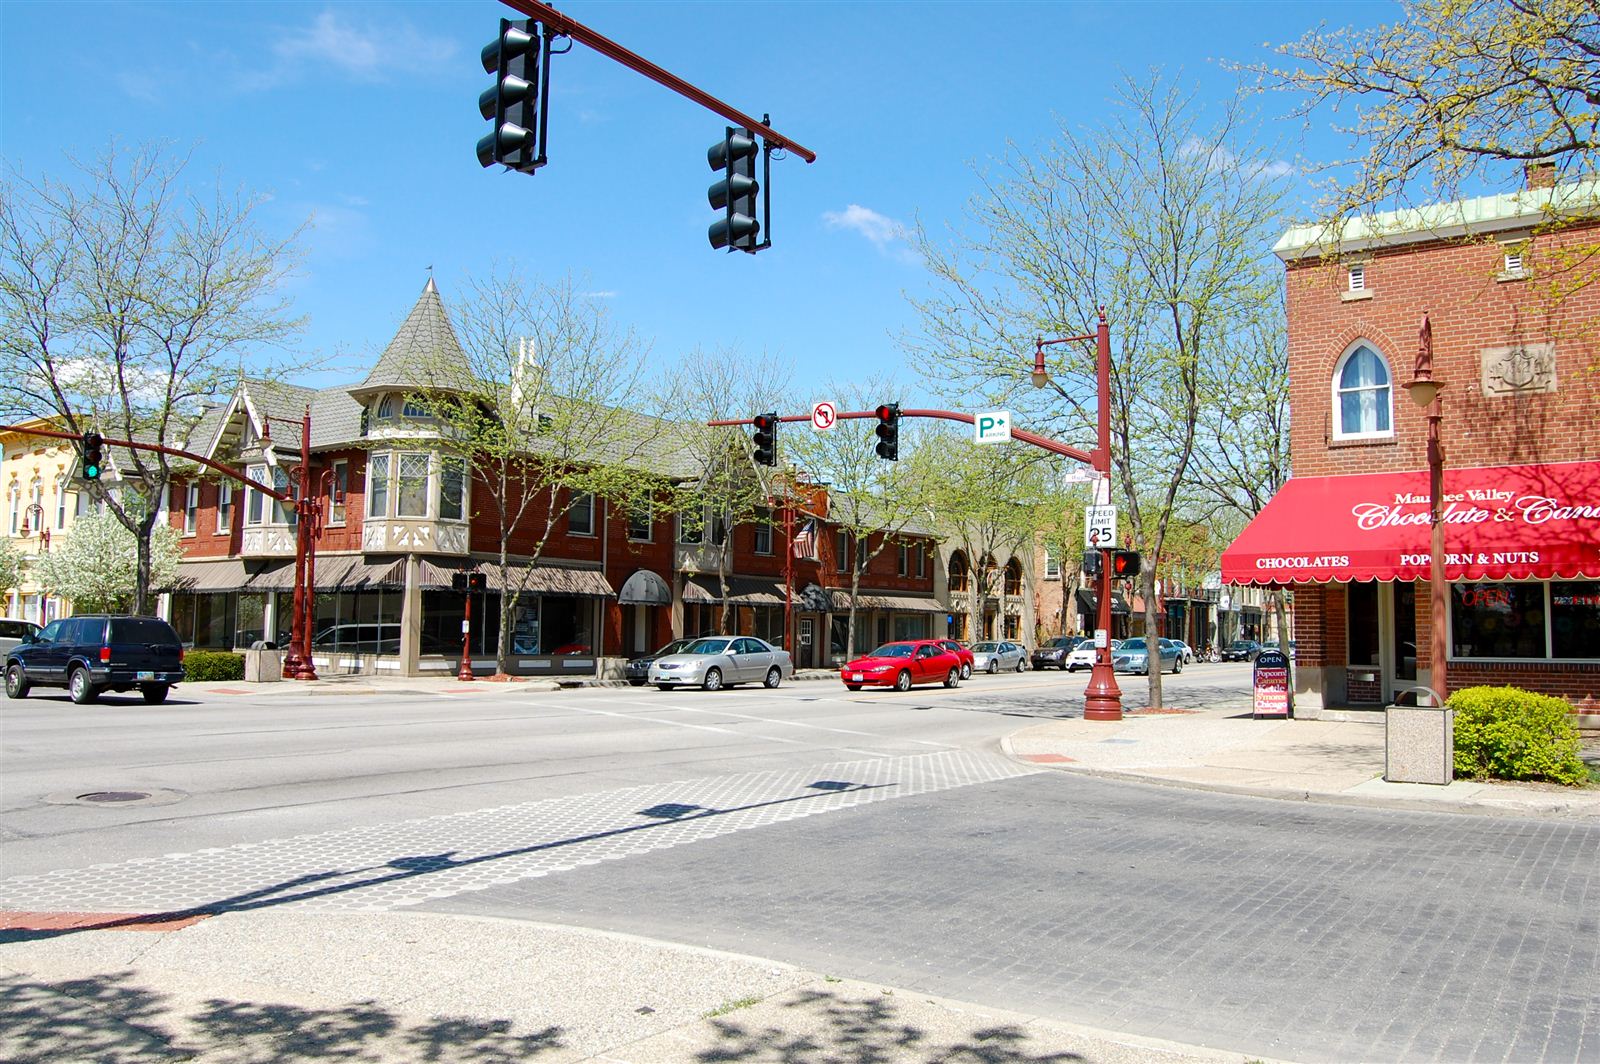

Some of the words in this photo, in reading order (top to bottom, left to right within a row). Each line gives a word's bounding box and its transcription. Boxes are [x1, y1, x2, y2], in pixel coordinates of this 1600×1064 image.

[1466, 489, 1515, 502] Valley
[1352, 503, 1489, 530] Choclate
[1494, 508, 1515, 522] &
[1089, 528, 1112, 542] 25
[1256, 556, 1350, 569] CHOCOLATES
[1400, 553, 1474, 566] POPORN
[1477, 553, 1490, 564] &
[1493, 551, 1539, 563] NUTS
[1462, 589, 1510, 607] OPEN
